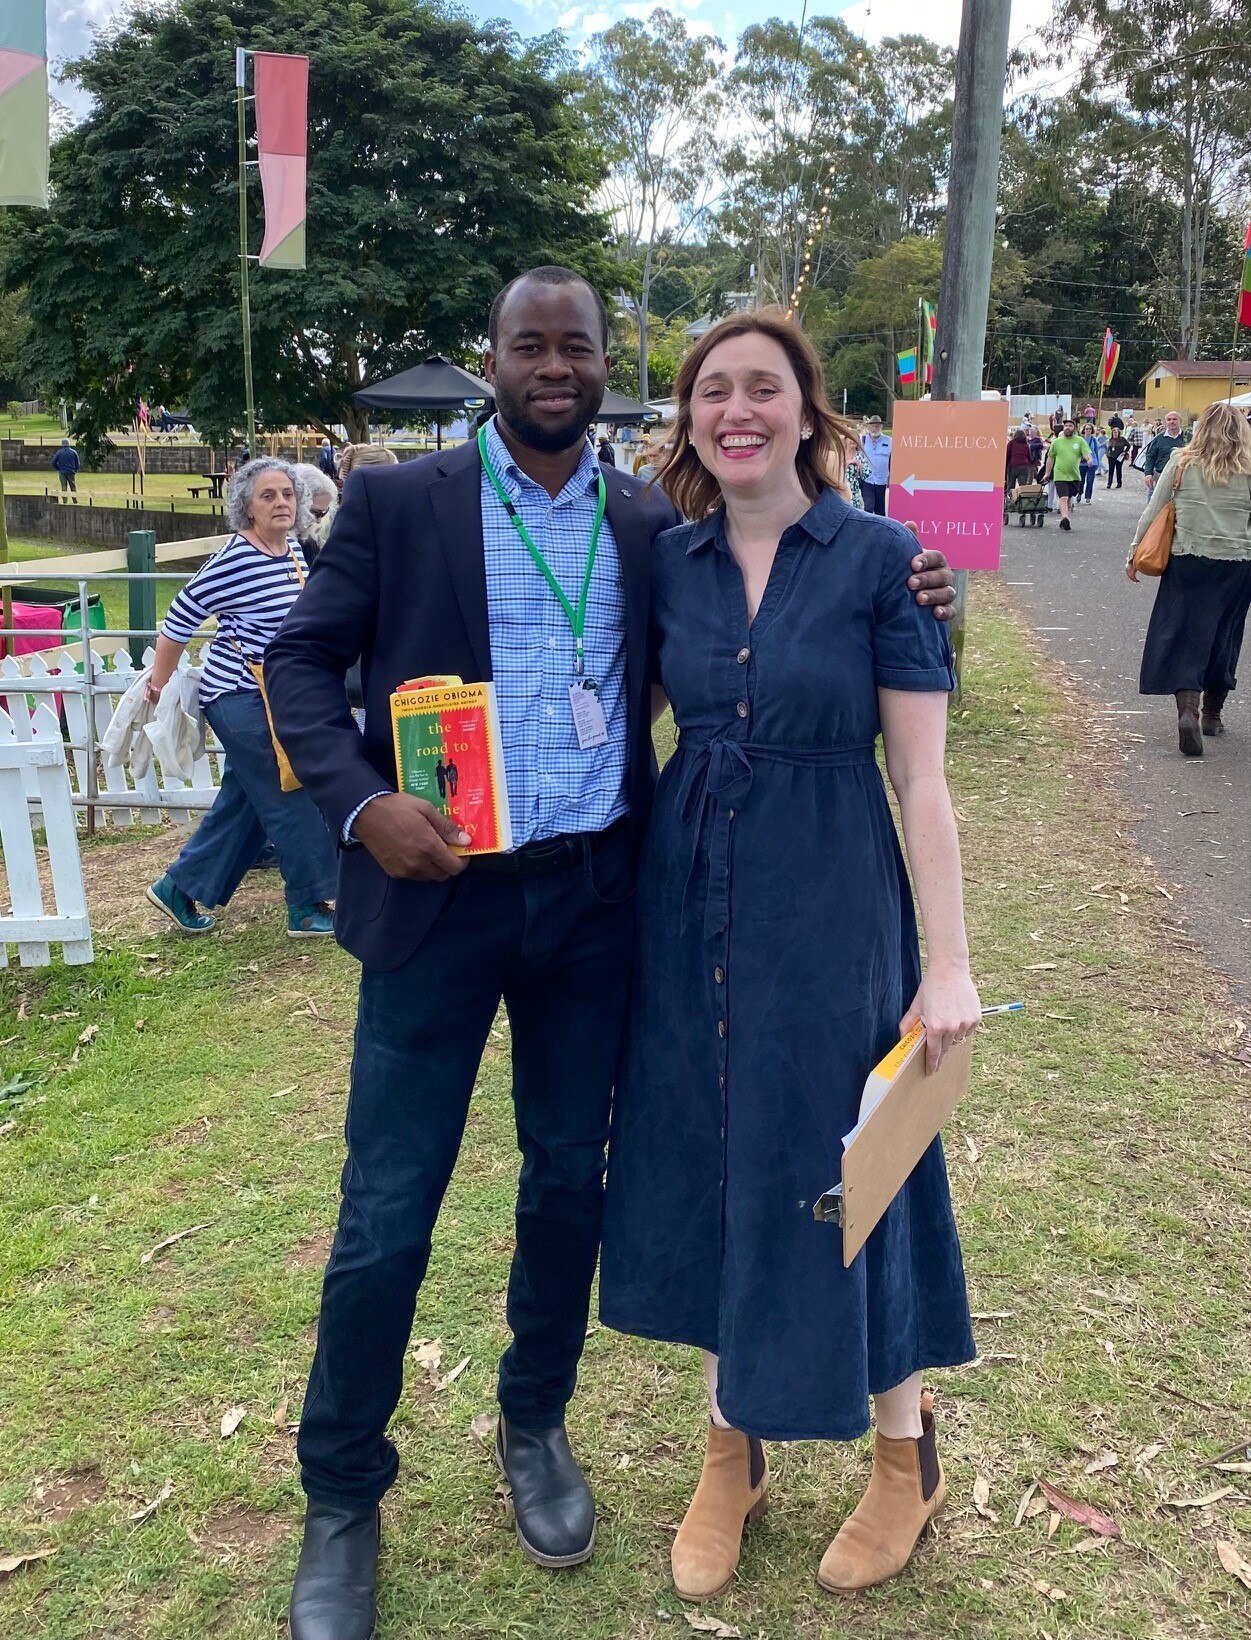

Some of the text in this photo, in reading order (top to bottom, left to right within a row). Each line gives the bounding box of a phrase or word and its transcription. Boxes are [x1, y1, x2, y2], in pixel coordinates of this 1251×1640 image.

[900, 435, 998, 449] MELALEUCA
[946, 521, 994, 536] PILLY
[394, 689, 483, 707] CHIGOZIE OBIOMA
[428, 722, 452, 735] the
[416, 741, 469, 757] road to
